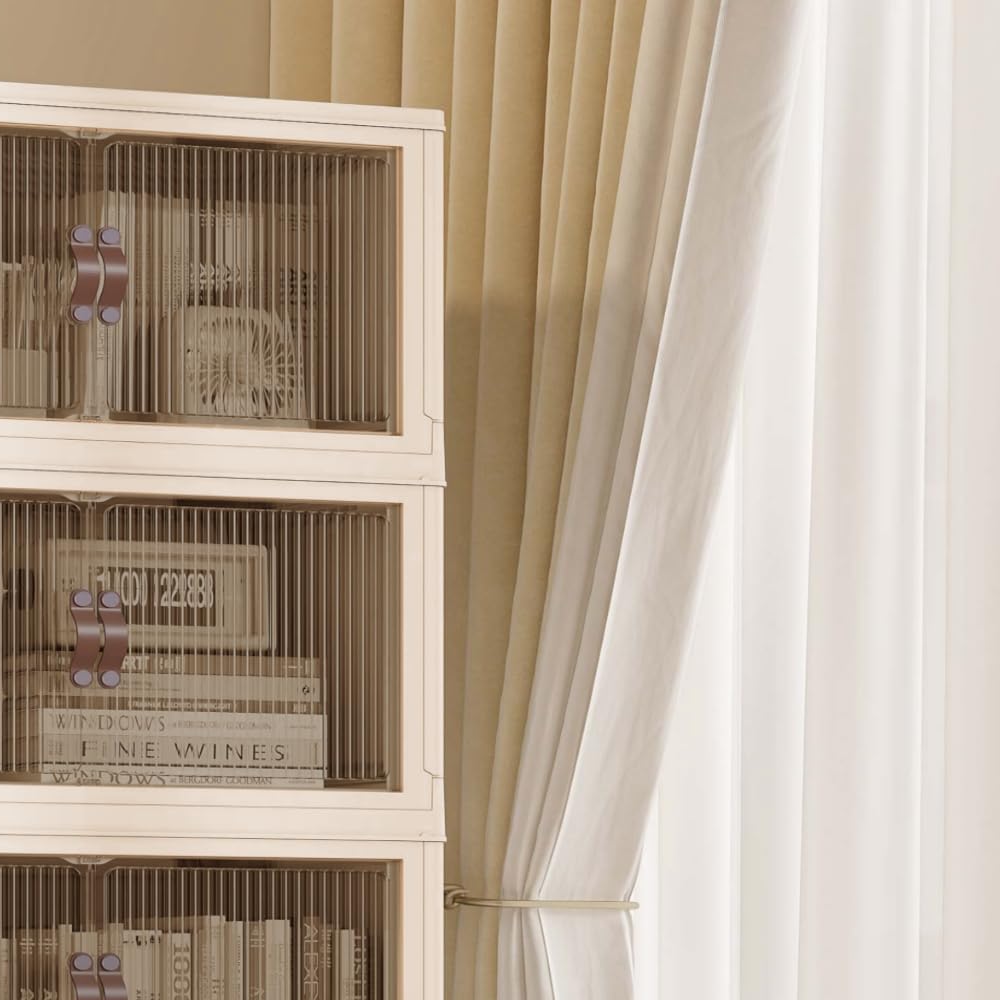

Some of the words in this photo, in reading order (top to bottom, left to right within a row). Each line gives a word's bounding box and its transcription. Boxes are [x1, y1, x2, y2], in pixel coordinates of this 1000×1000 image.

[51, 713, 165, 731] WINDOWS
[82, 741, 156, 759] FINE
[173, 742, 285, 761] WINES
